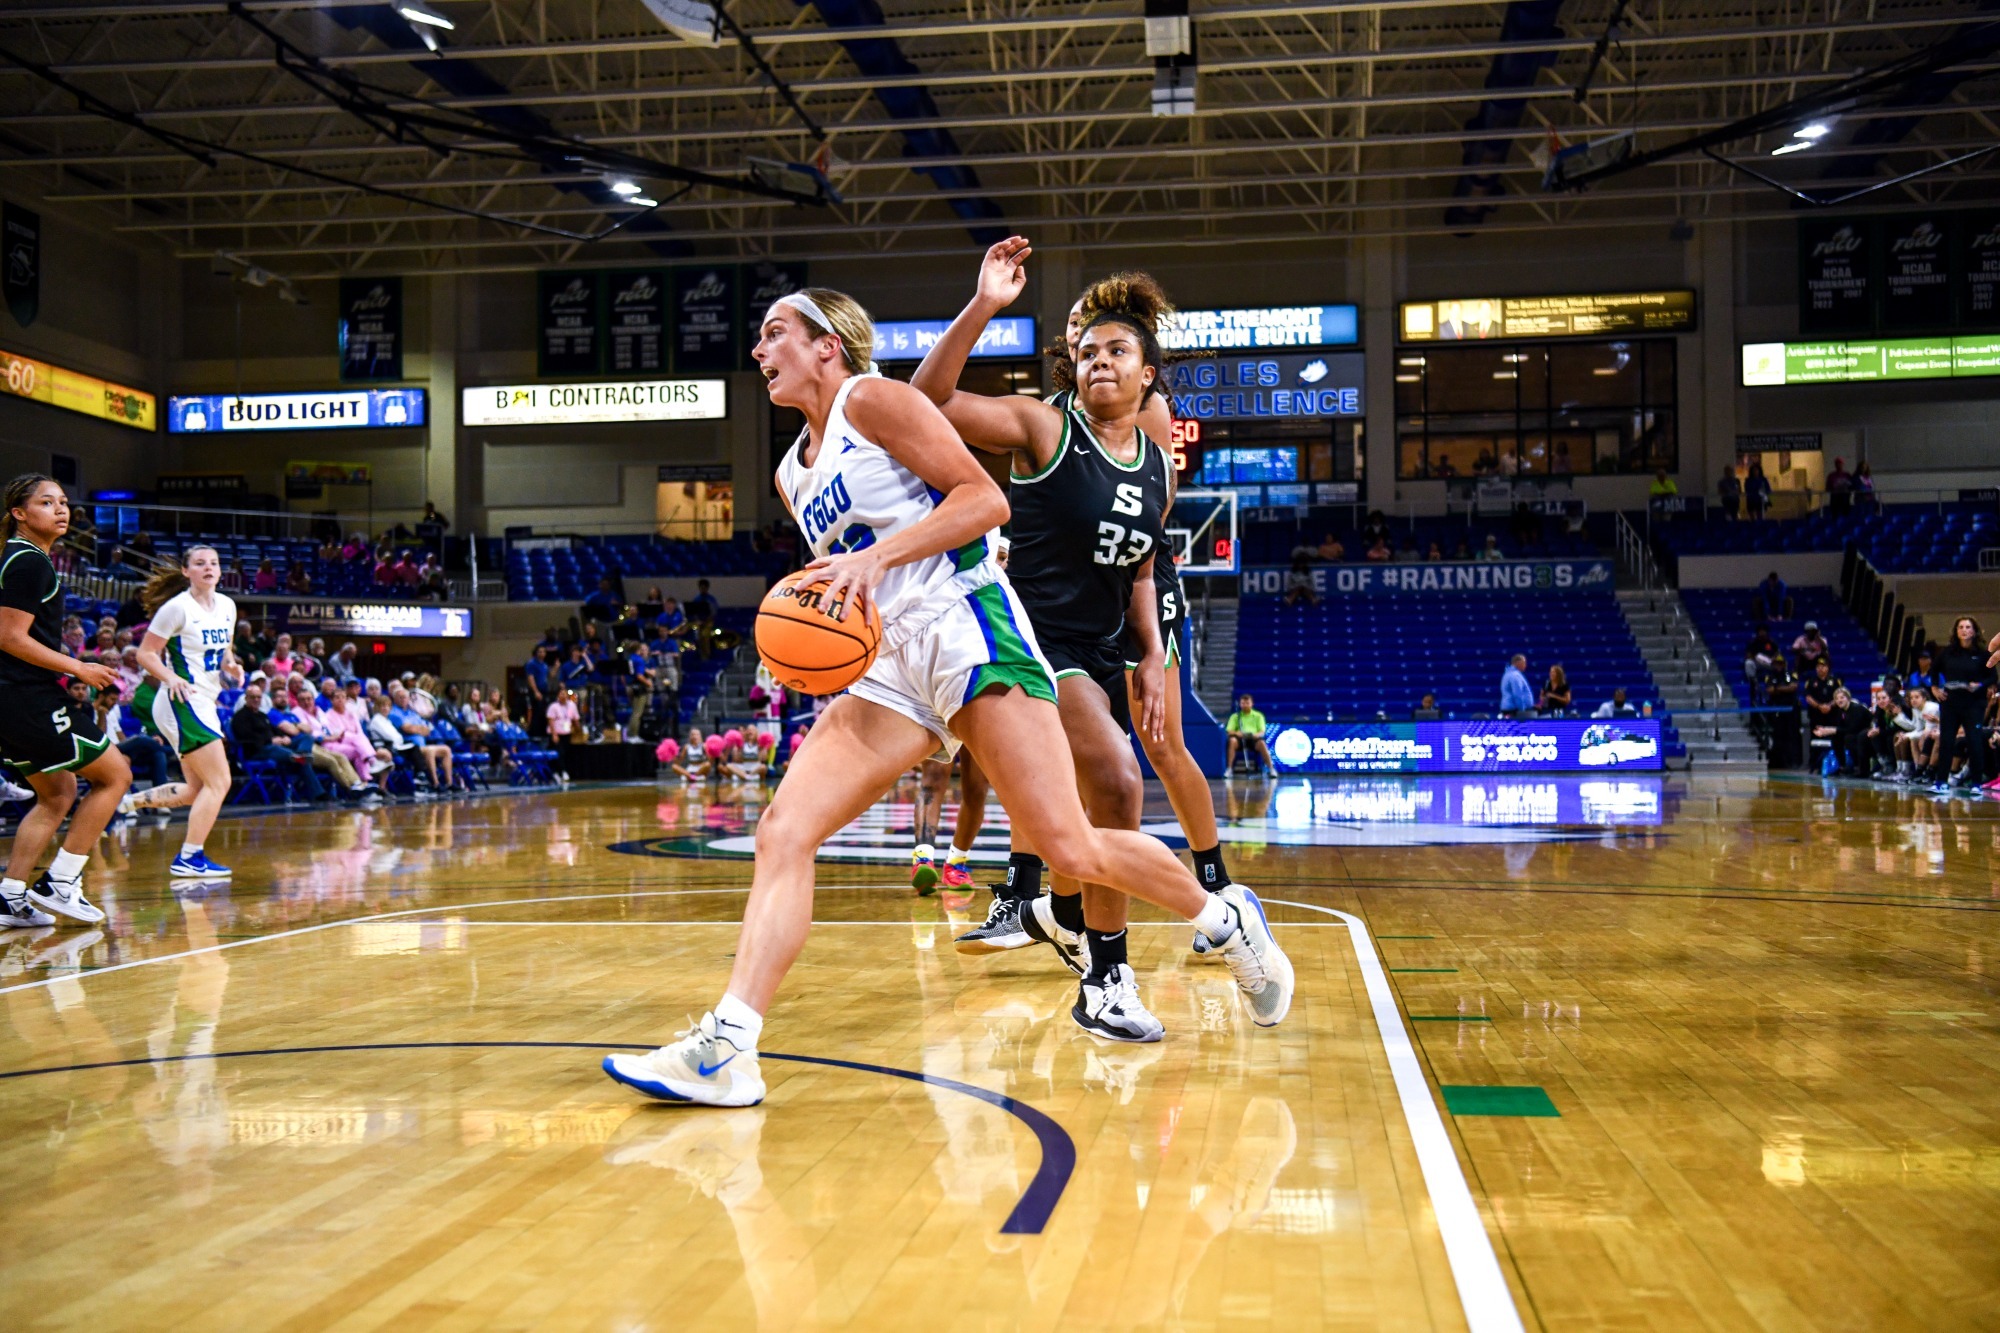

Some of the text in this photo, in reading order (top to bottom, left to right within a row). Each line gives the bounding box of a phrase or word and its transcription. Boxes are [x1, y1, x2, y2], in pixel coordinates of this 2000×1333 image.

[1822, 266, 1852, 279] NCAA
[1902, 262, 1932, 275] NCAA
[893, 328, 909, 350] is
[974, 321, 1021, 354] pital
[1156, 326, 1322, 349] NDATION SUITE
[8, 360, 35, 394] 60
[1173, 361, 1280, 388] AGLES
[550, 383, 699, 407] CONTRACTORS
[1174, 388, 1358, 418] XCELLENCE
[229, 400, 360, 422] BUD LIGHT
[803, 471, 851, 545] FGCU
[1111, 483, 1142, 517] S
[1094, 521, 1153, 567] 33
[1243, 569, 1326, 593] HOE
[1337, 569, 1372, 592] OF
[289, 604, 336, 619] ALFIE
[1162, 591, 1177, 622] S
[52, 706, 71, 734] S
